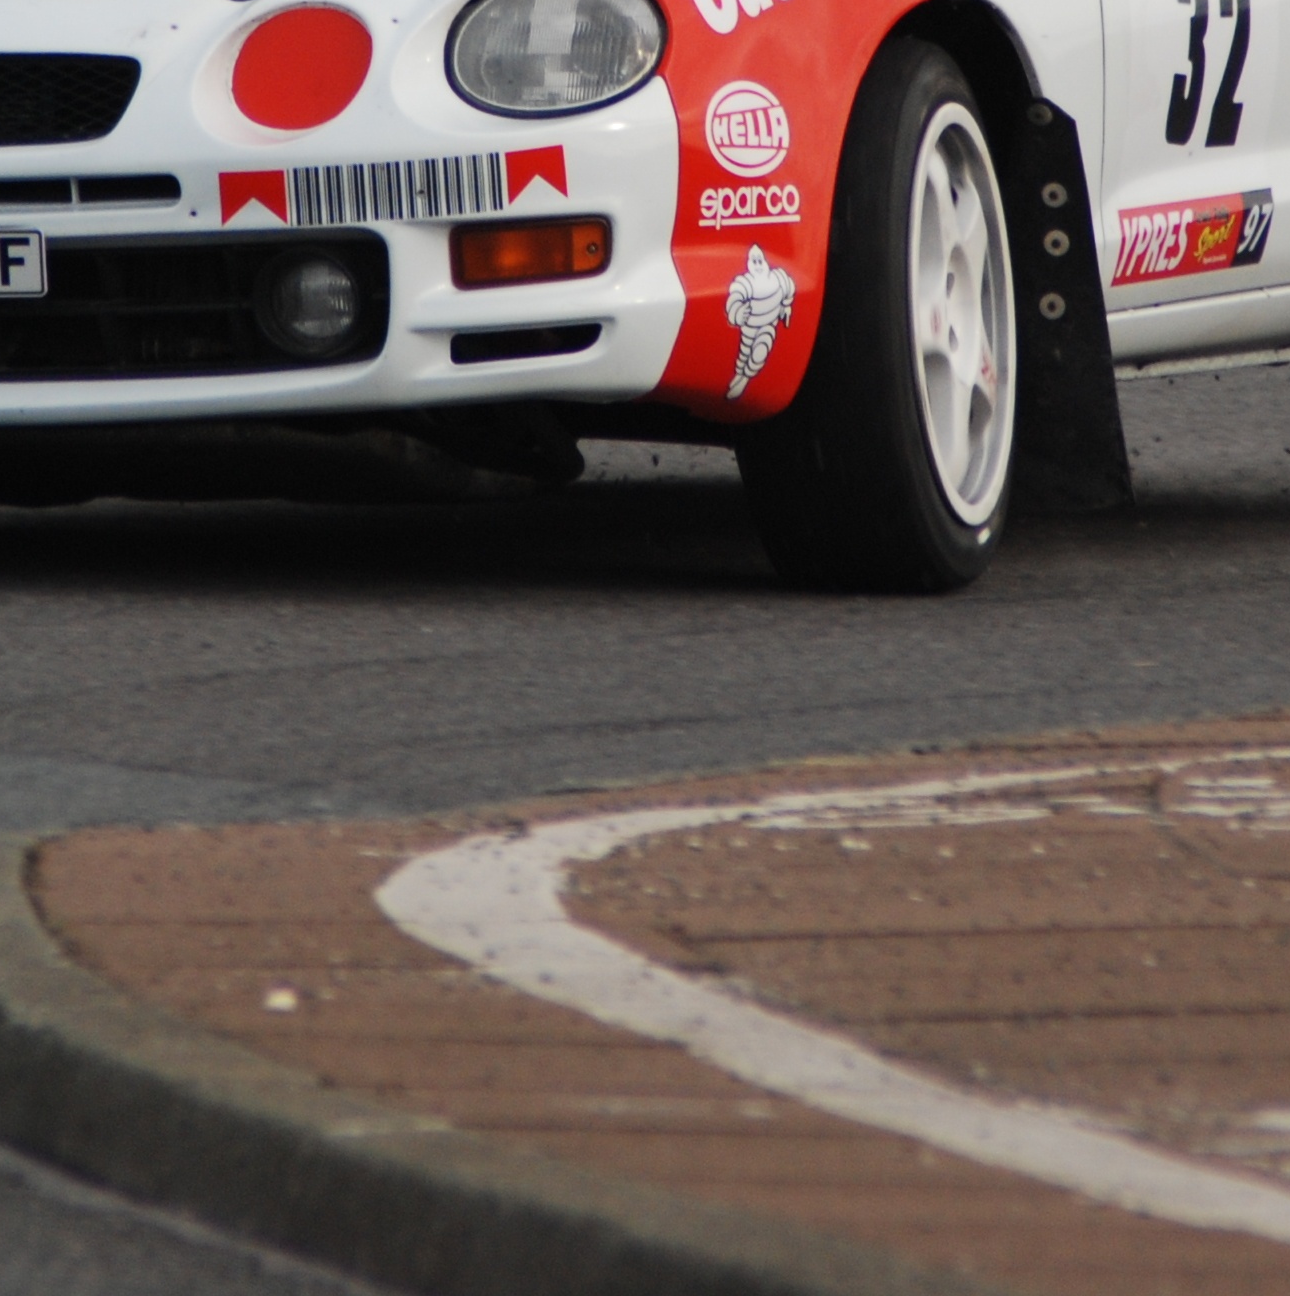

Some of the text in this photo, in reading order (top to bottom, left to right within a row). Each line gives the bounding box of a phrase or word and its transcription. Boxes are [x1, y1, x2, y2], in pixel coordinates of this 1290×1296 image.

[713, 106, 790, 148] HELLA
[700, 184, 800, 230] sparco
[1115, 208, 1194, 278] YPRES
[1237, 203, 1274, 254] 97
